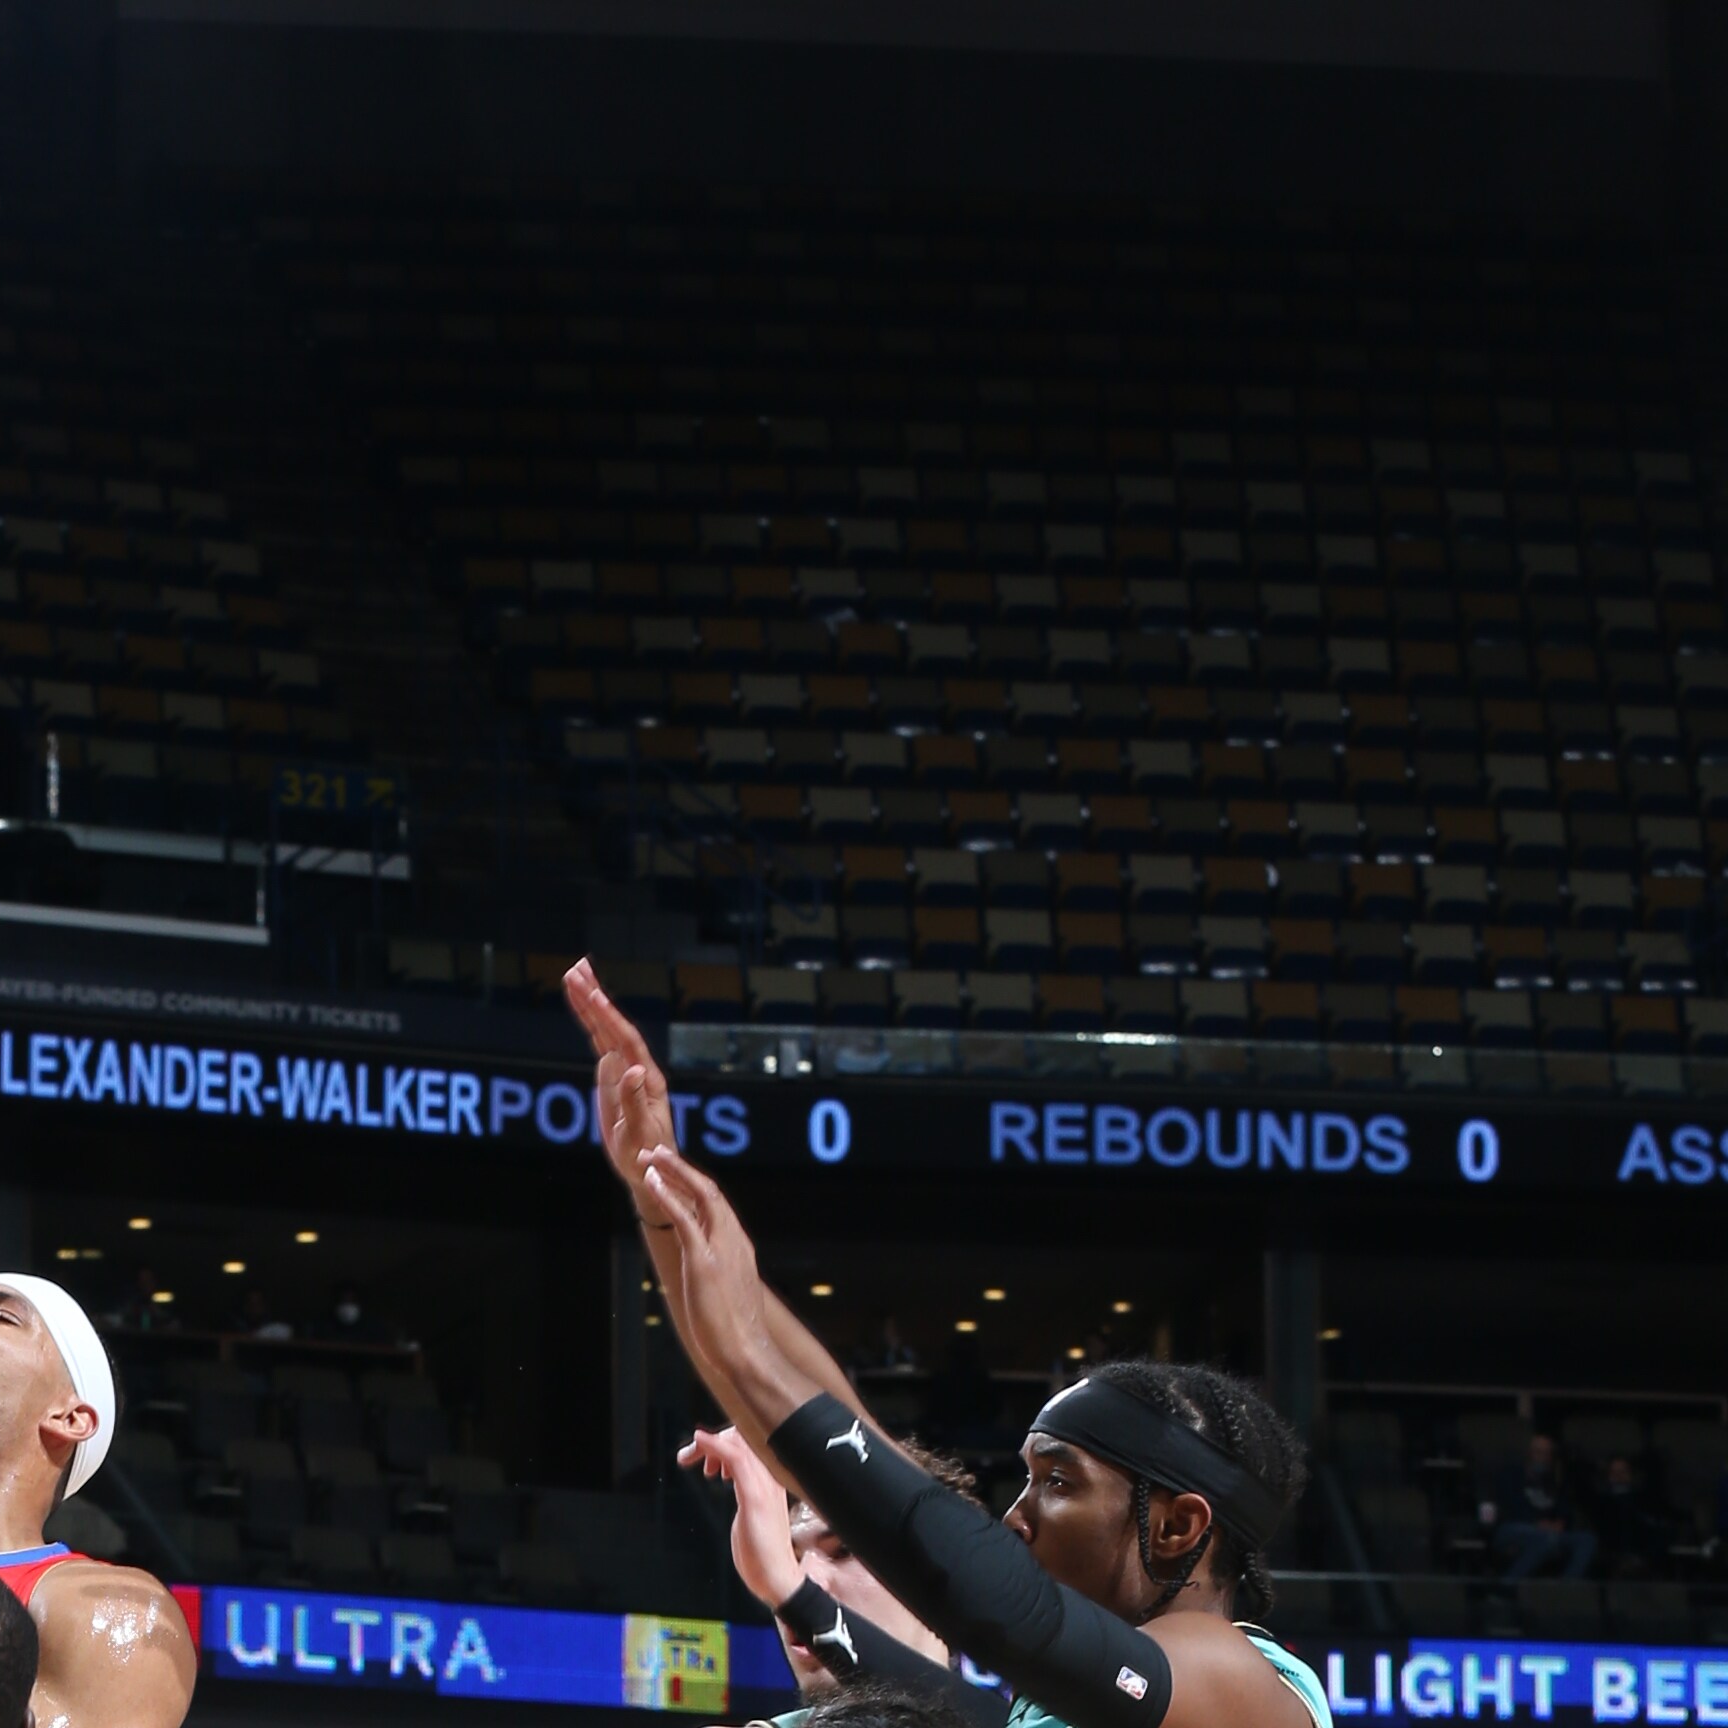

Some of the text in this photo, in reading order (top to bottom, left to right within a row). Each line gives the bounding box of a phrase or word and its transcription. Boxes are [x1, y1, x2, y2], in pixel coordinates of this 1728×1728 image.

[160, 991, 303, 1024] COMMUNITY
[306, 1008, 403, 1034] TICKETS
[489, 1075, 852, 1163] POTS 0
[990, 1101, 1500, 1183] REBOUNDS 0
[225, 1599, 502, 1684] ULTRA
[1326, 1650, 1728, 1727] LIGHT BEE
